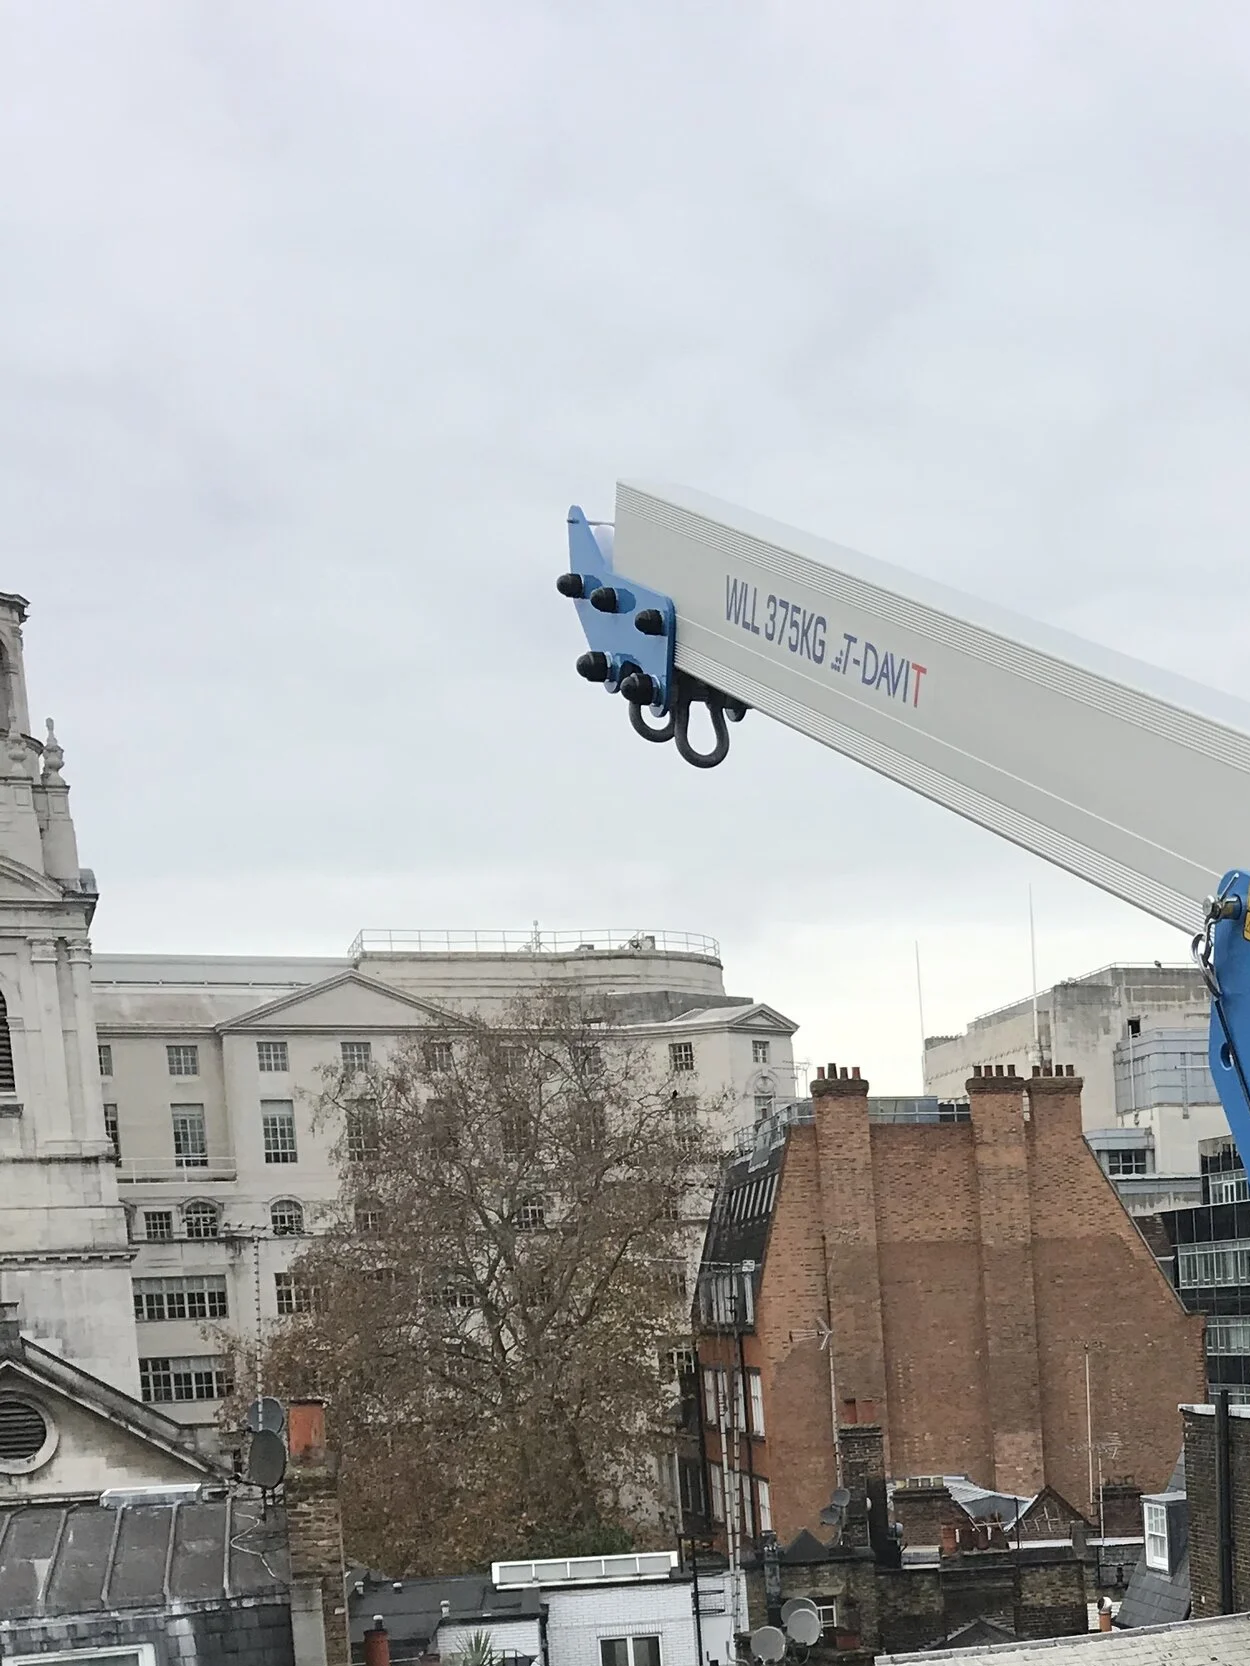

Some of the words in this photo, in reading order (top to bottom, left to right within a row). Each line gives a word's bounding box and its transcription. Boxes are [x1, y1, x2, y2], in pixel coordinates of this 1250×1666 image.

[726, 574, 760, 635] WLL
[765, 594, 827, 664] 375KG
[843, 632, 927, 708] T-DAVIT
